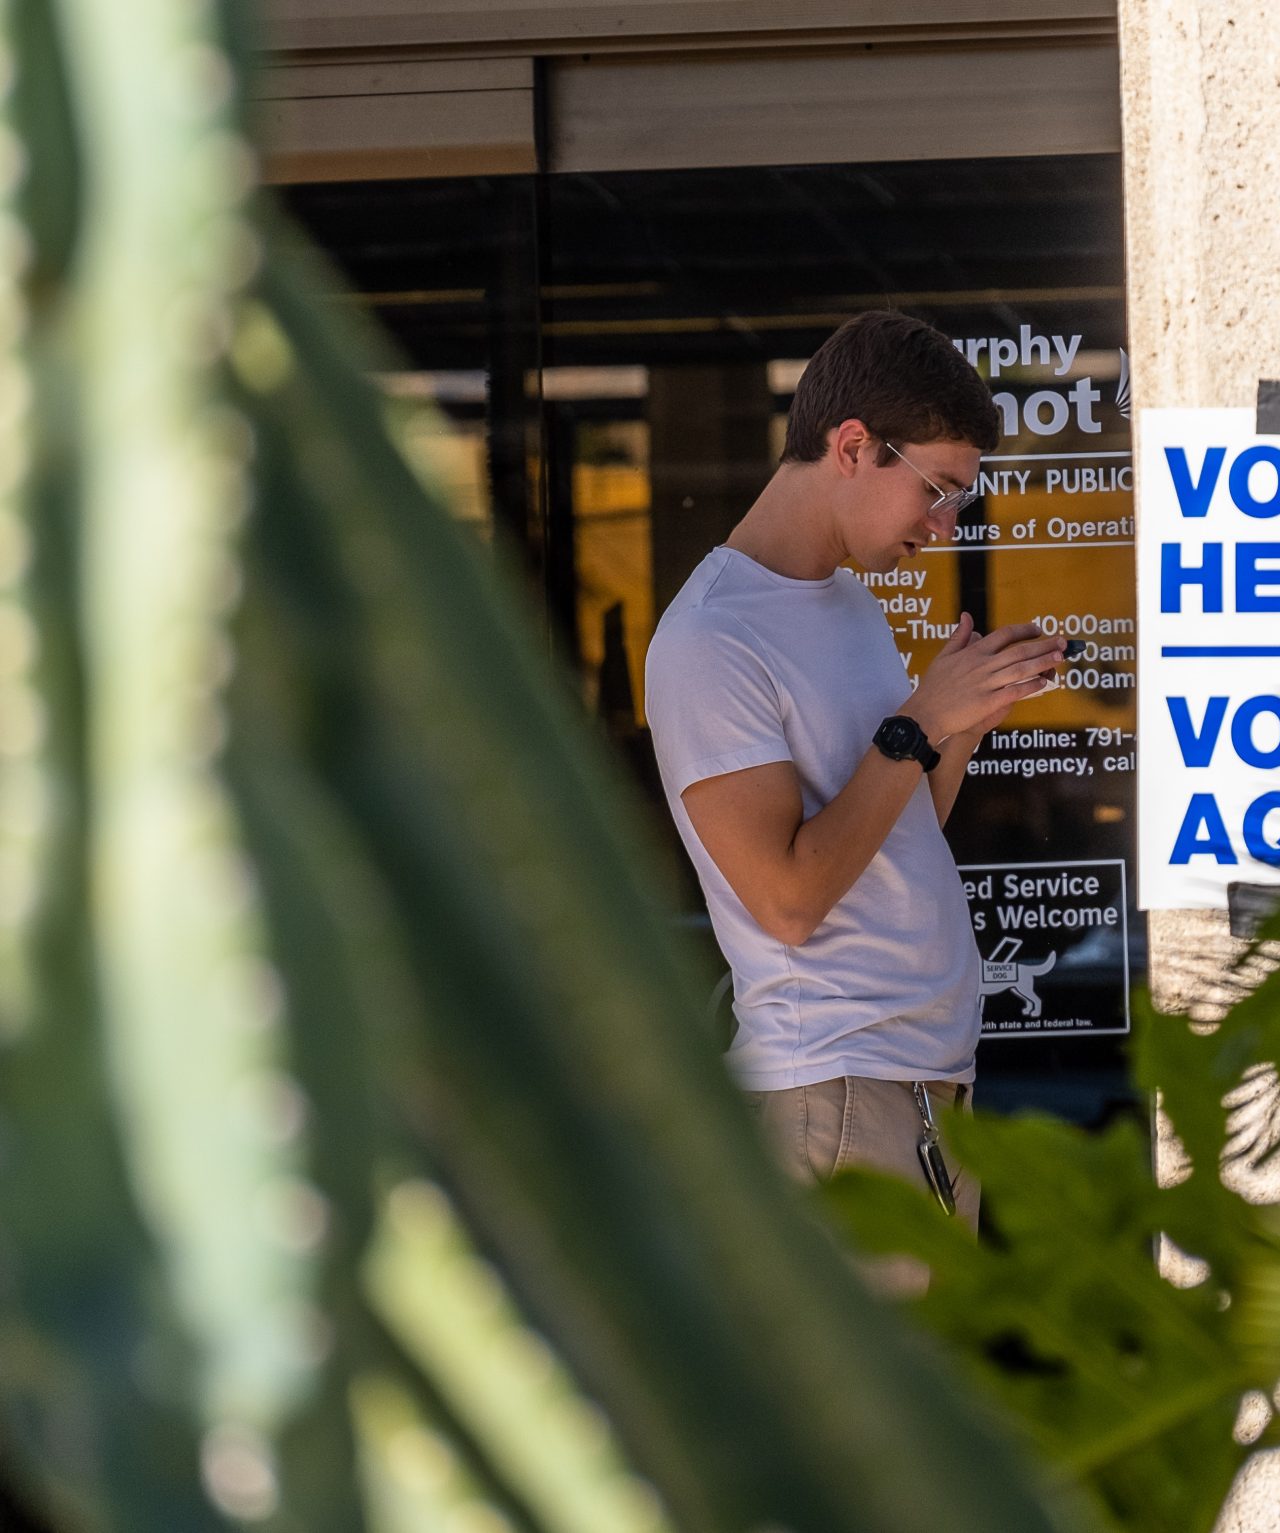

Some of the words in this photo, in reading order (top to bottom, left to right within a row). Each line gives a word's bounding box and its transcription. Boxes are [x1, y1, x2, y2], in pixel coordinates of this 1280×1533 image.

[1046, 466, 1134, 494] PUBLIC
[931, 523, 1001, 541] ours
[1012, 518, 1036, 539] of
[1047, 515, 1135, 541] Operati
[842, 566, 927, 590] unday
[1032, 614, 1135, 636] 10:00am
[1054, 669, 1136, 690] :00am
[992, 729, 1077, 749] infoline:
[1085, 727, 1137, 748] 791-
[967, 756, 1094, 778] emergency,
[1103, 752, 1135, 771] cal
[1003, 872, 1099, 899] Service
[997, 905, 1118, 930] Welcome
[986, 964, 1013, 972] SERVICE
[993, 972, 1008, 980] DOG
[999, 1021, 1022, 1030] state
[1025, 1020, 1041, 1028] and
[1044, 1018, 1074, 1028] federal
[1076, 1018, 1093, 1027] law.
